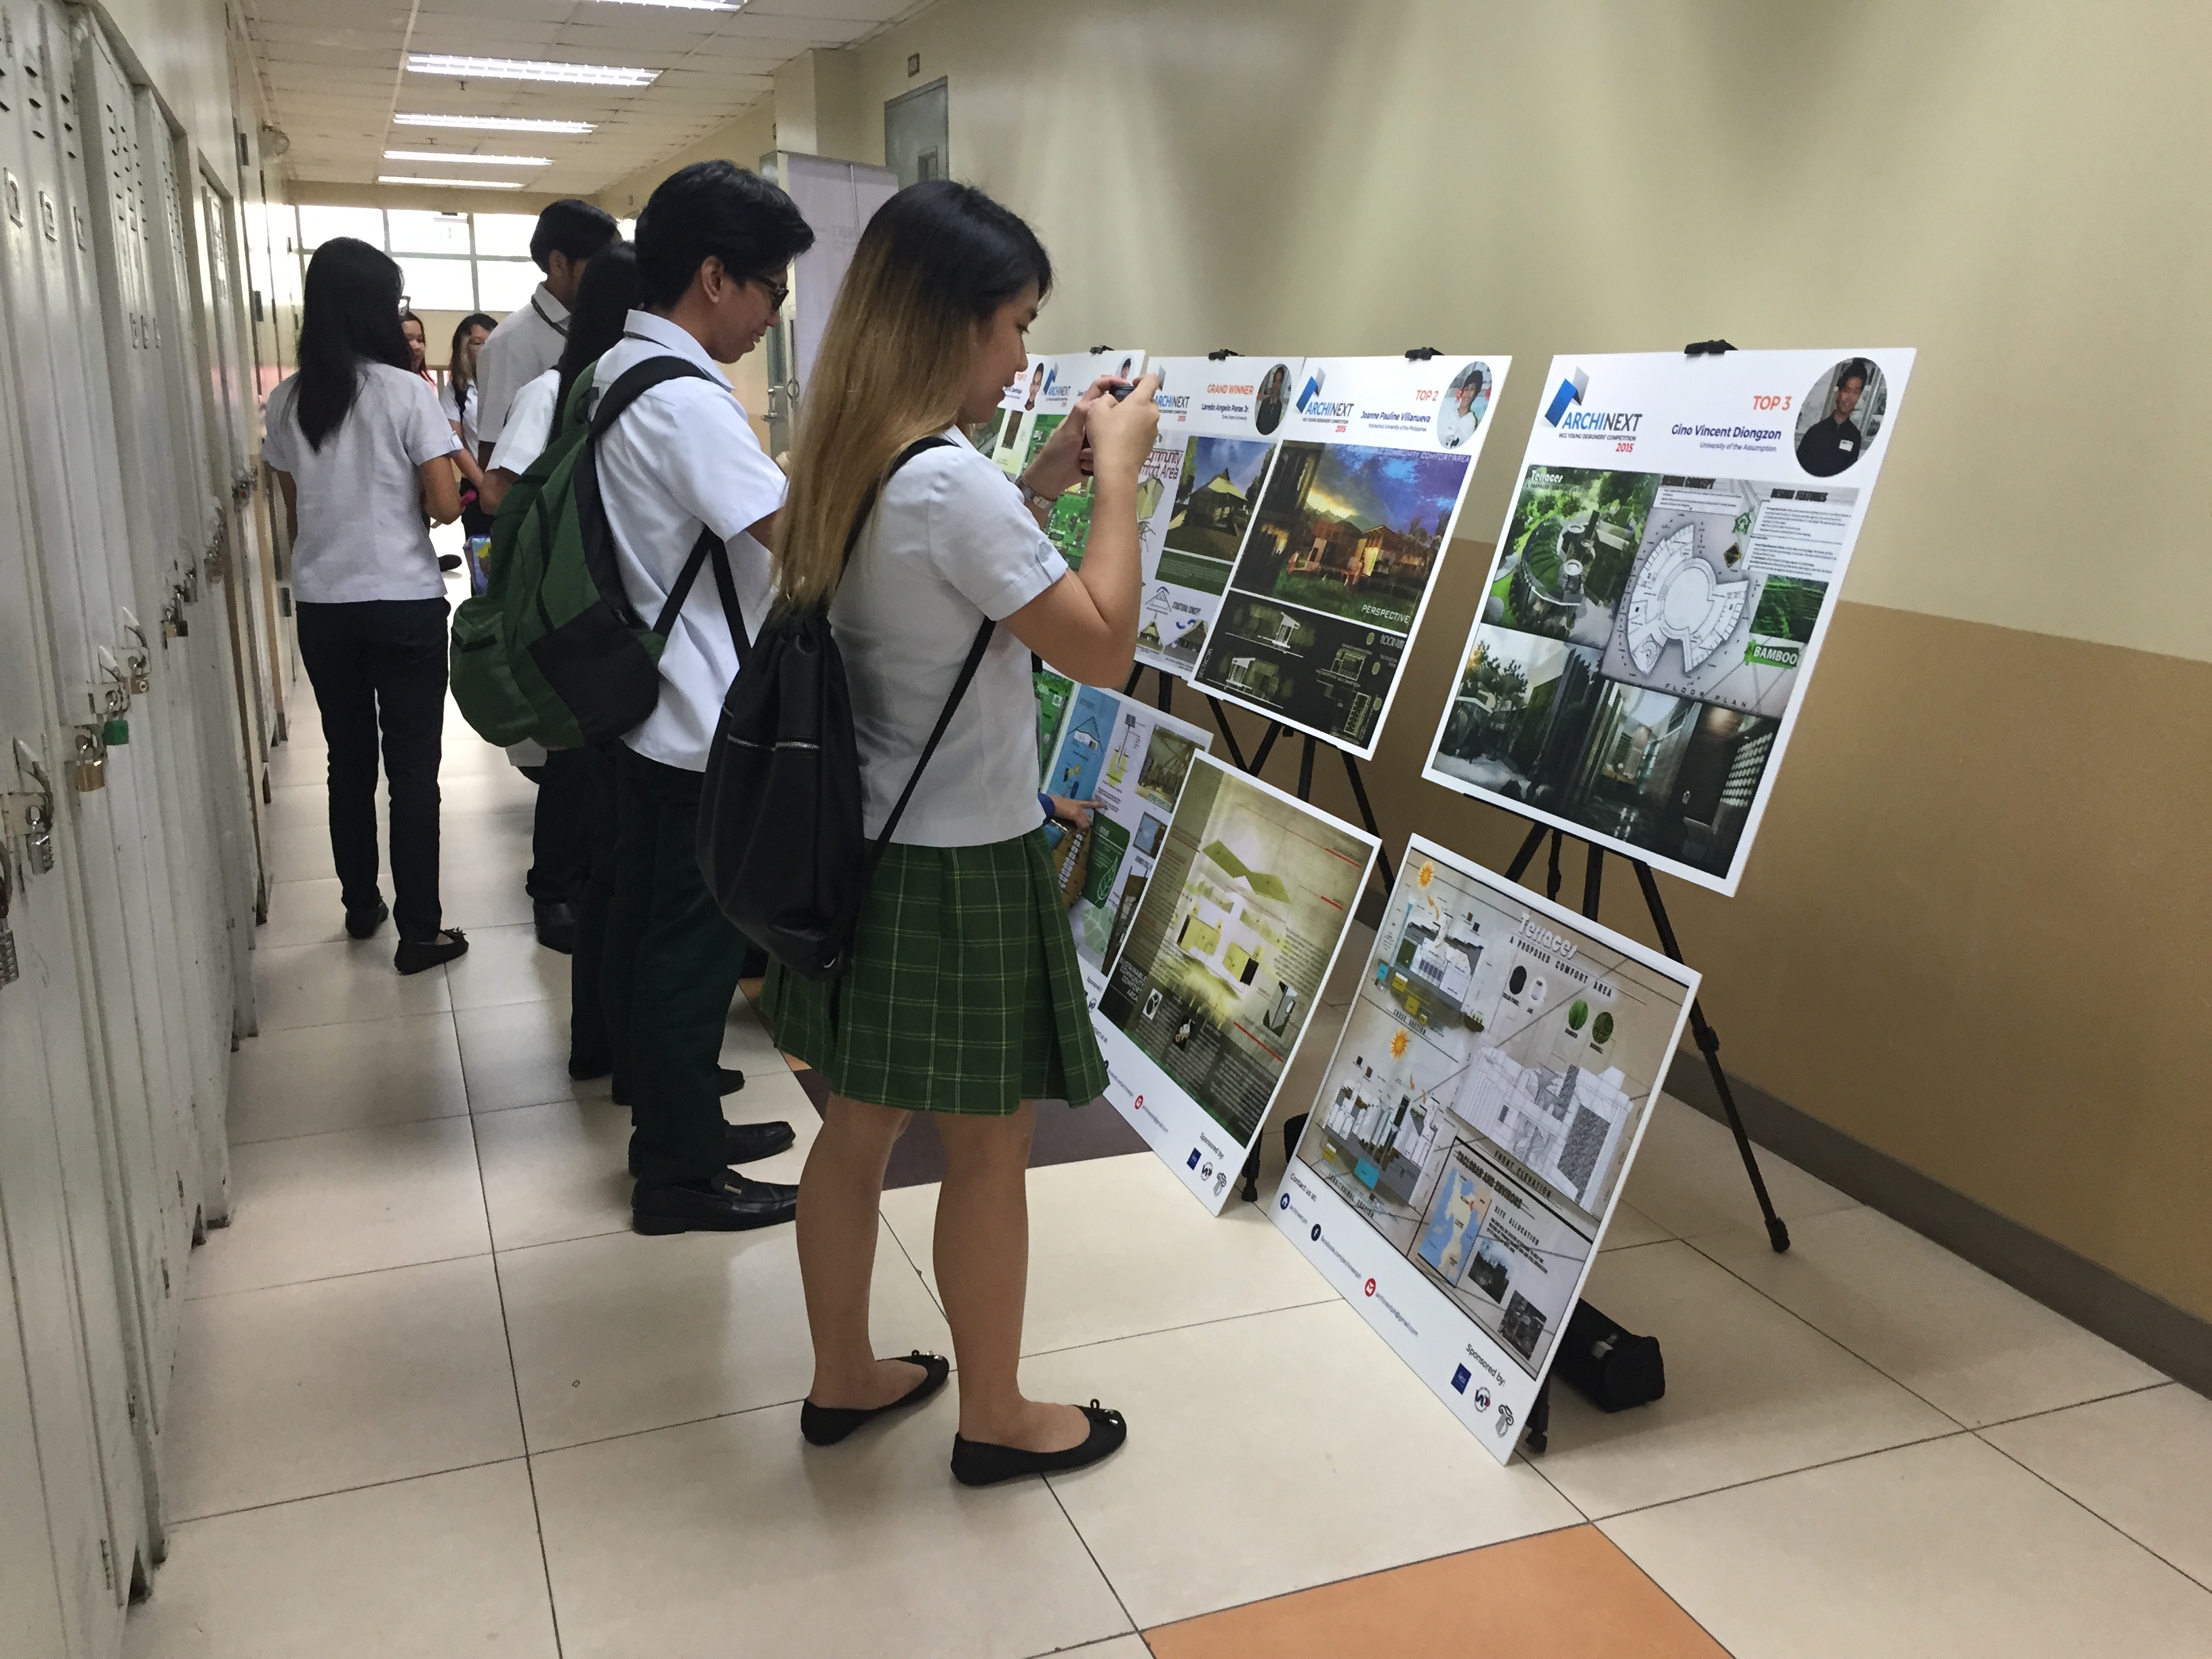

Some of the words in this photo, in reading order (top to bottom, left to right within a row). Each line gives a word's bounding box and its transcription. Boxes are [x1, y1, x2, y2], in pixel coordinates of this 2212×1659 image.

[1207, 384, 1228, 394] GRAND
[1228, 384, 1254, 395] WINNER
[1416, 389, 1432, 401] TOP
[1432, 390, 1438, 401] 2
[1305, 402, 1354, 417] ARCHINEXT
[1753, 395, 1781, 410] TOP
[1782, 396, 1793, 411] 3
[1561, 411, 1643, 432] ARCHINEXT
[1671, 424, 1693, 436] Gino
[1695, 424, 1732, 438] Vincent
[1733, 426, 1782, 441] Diongzon
[1420, 452, 1451, 462] COMFORT
[1616, 443, 1634, 453] 2015
[1160, 462, 1179, 480] Area
[1361, 604, 1410, 624] PERSPECTIVE
[1754, 645, 1797, 665] BAMBOO
[1665, 683, 1704, 698] FLOOR
[1715, 695, 1747, 708] PLAN
[1519, 911, 1578, 960] Terraces
[1509, 936, 1514, 944] A
[1517, 939, 1551, 964] PROPOSED
[1555, 960, 1589, 985] COMFORT
[1593, 981, 1612, 998] AREA
[1290, 1172, 1307, 1192] Contact
[1305, 1189, 1312, 1197] us
[1466, 1343, 1498, 1377] Sponsored
[1496, 1372, 1506, 1386] by:
